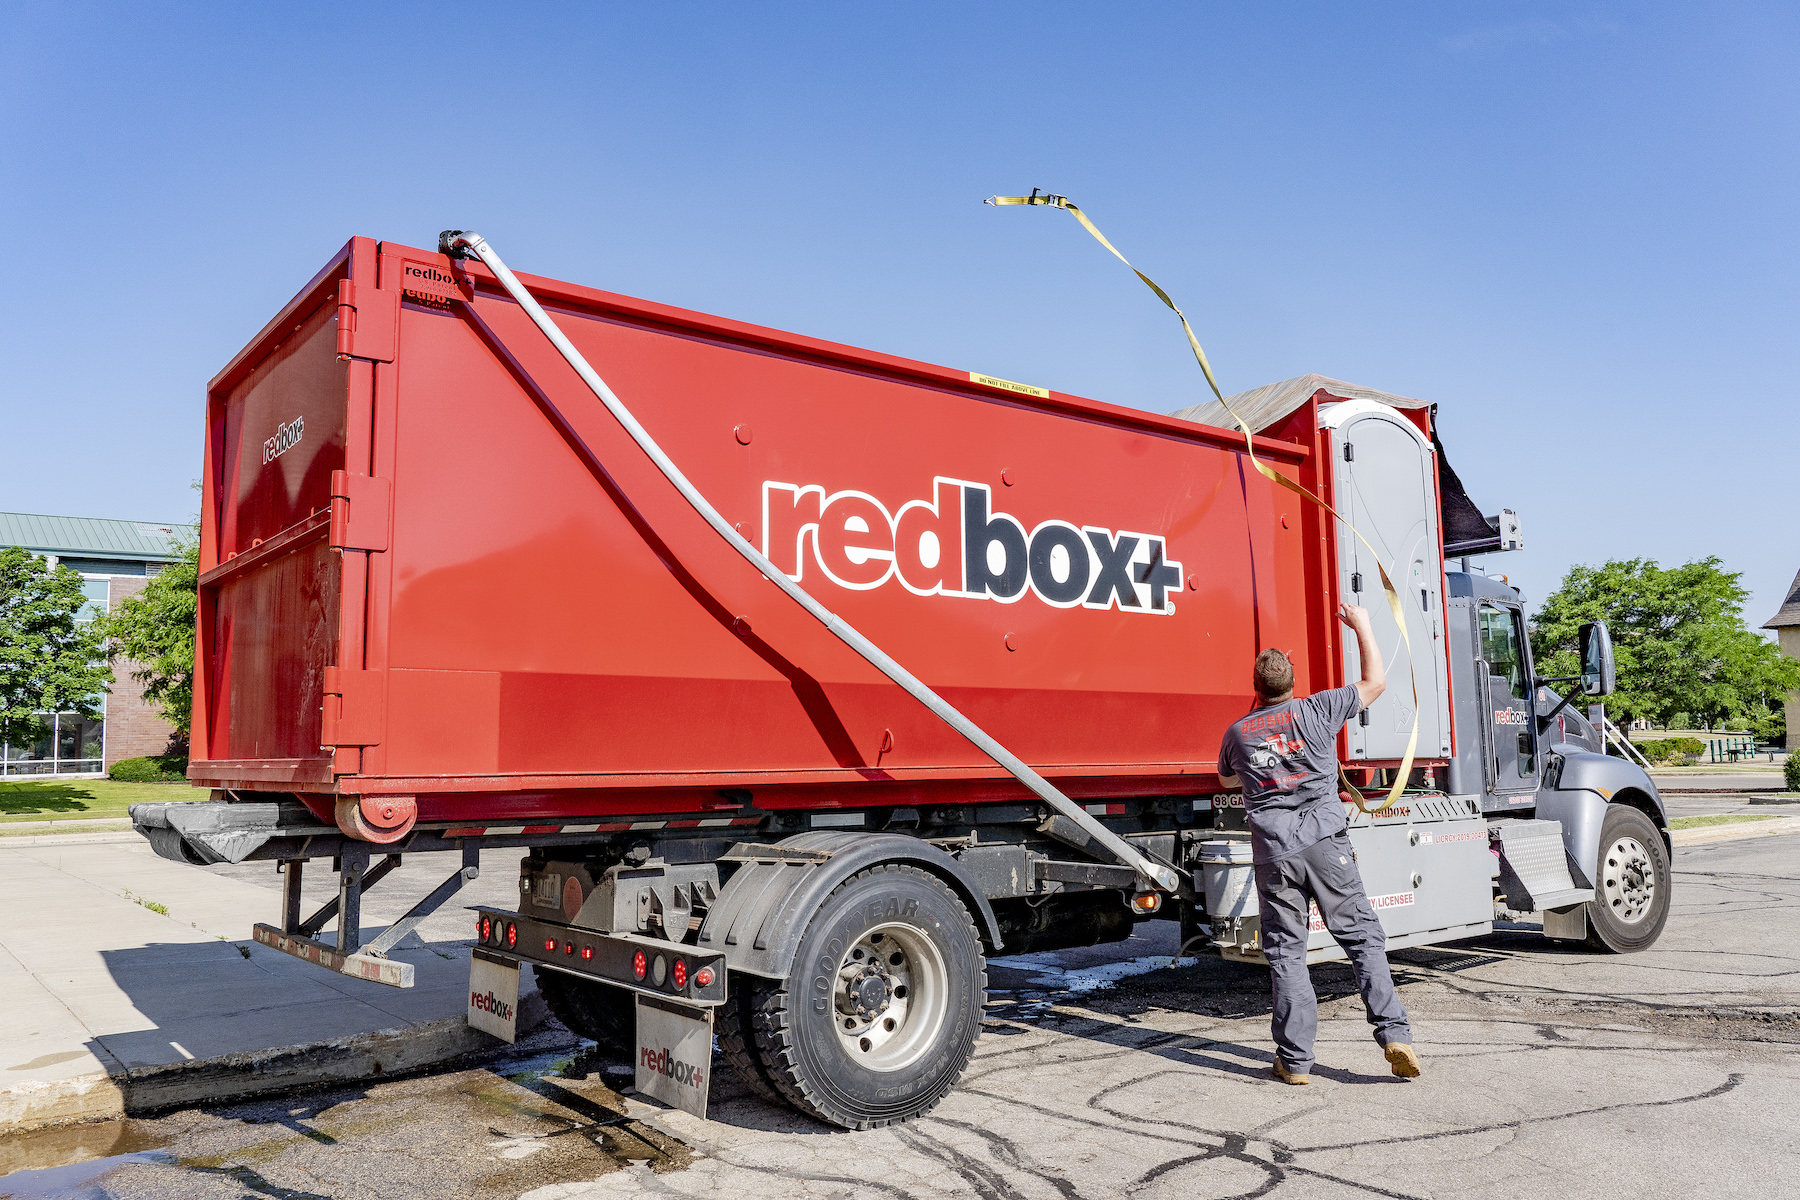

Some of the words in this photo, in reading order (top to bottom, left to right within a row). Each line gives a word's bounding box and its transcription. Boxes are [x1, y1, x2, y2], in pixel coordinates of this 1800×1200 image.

[405, 266, 472, 286] redbox+
[988, 379, 998, 387] NOT
[1000, 382, 1010, 390] FILL
[1011, 385, 1028, 393] ABOVE
[1029, 388, 1040, 396] LINE
[262, 415, 304, 465] redbox+
[762, 476, 1184, 615] redbox+
[1214, 796, 1227, 806] 98
[1230, 796, 1245, 806] GA
[1378, 893, 1413, 908] LICENSEE
[471, 991, 513, 1021] redbox+
[641, 1046, 703, 1089] redbox+
